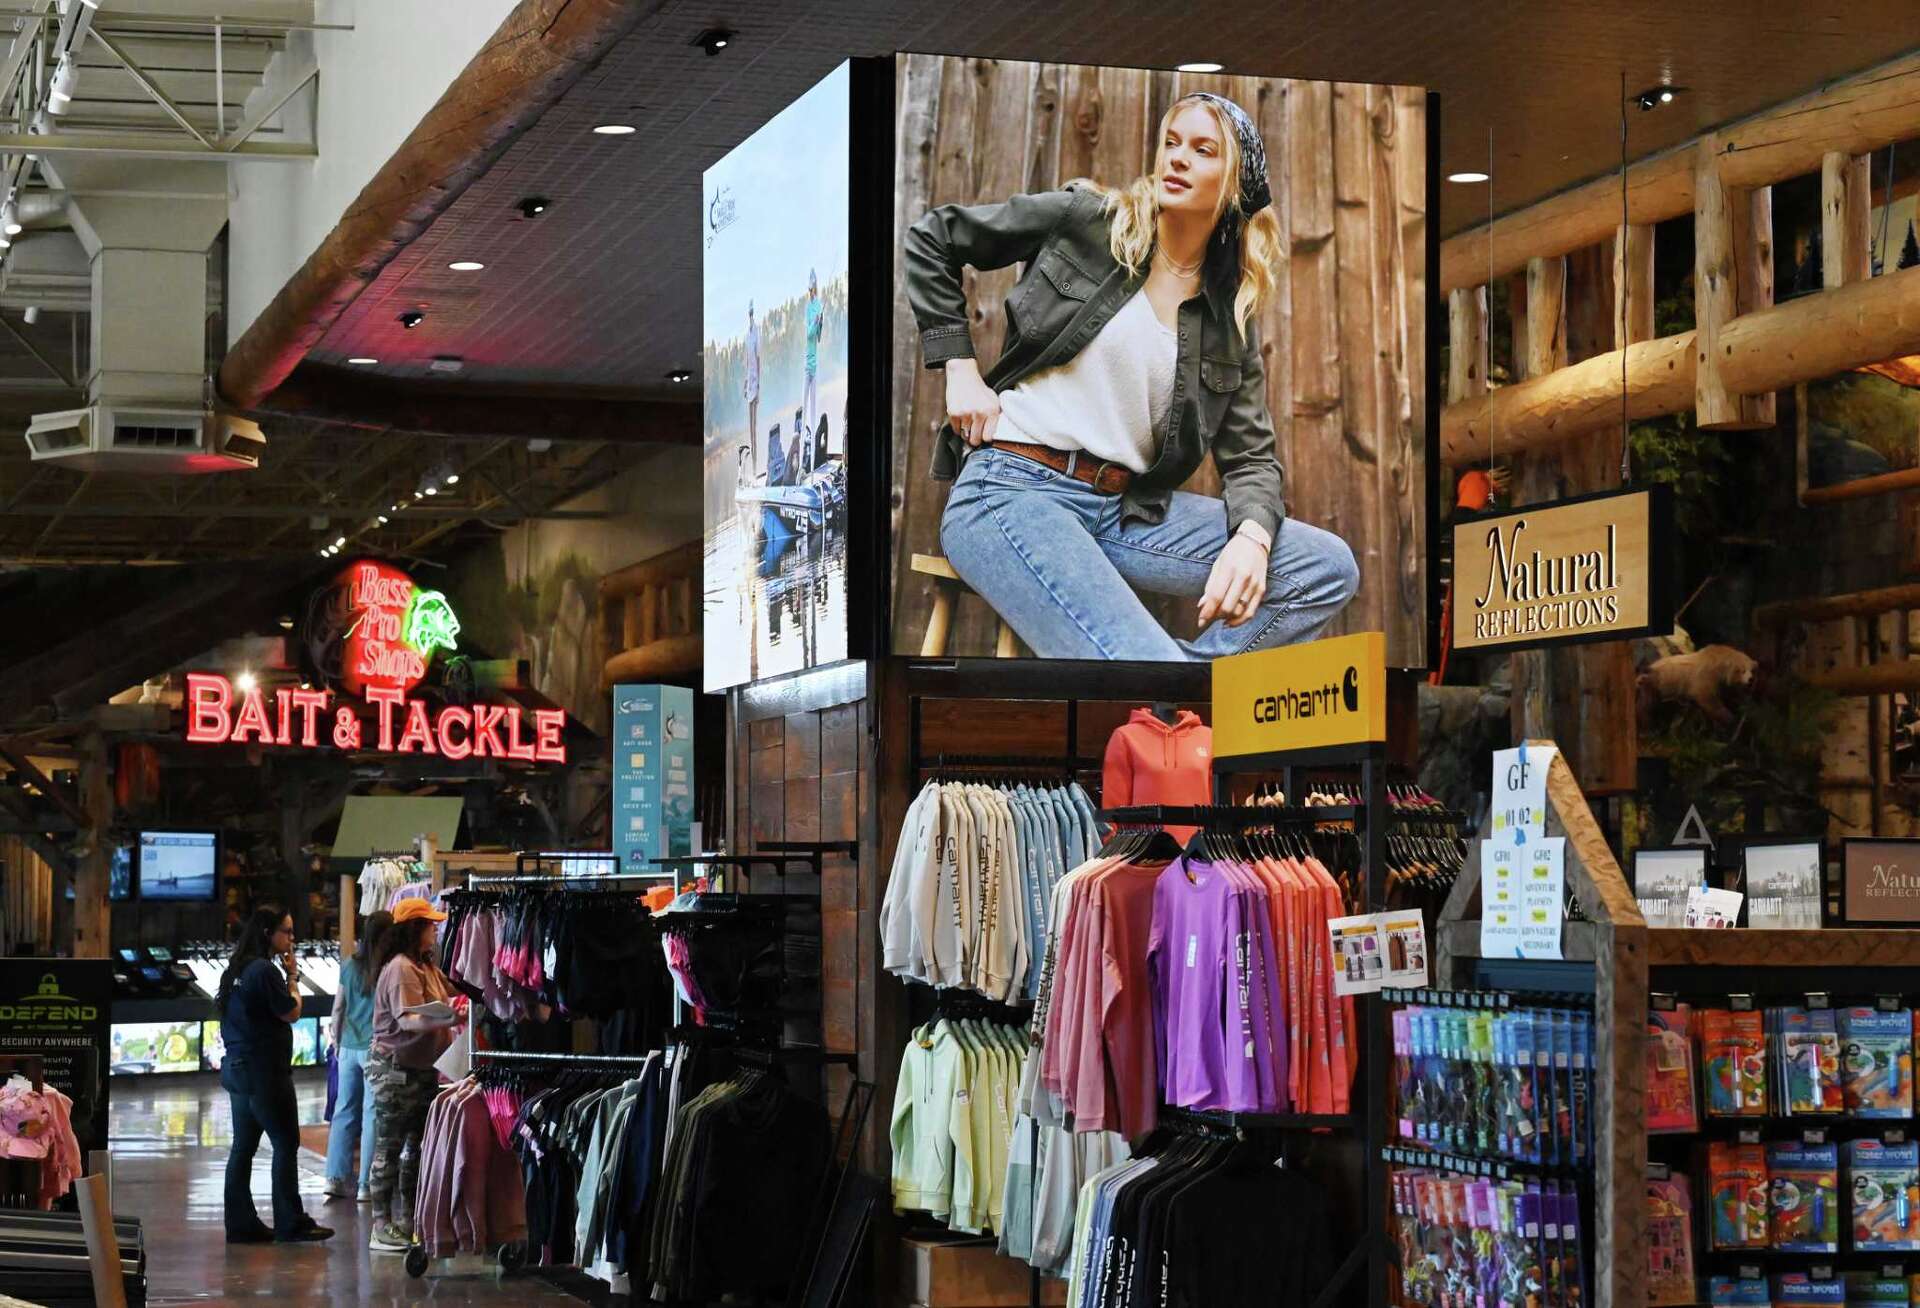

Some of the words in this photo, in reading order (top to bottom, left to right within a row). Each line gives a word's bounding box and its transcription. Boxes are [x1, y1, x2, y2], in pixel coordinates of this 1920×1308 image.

[1475, 520, 1617, 608] Natural
[358, 565, 413, 608] Bass
[360, 606, 400, 641] Pro
[1474, 595, 1618, 639] REFLECTIONS
[359, 641, 426, 683] Shops
[187, 672, 328, 747] BAIT
[333, 705, 362, 749] &
[365, 685, 566, 763] TACKLE
[1253, 682, 1340, 724] carhartt
[1507, 762, 1531, 791] GF
[1505, 809, 1515, 826] 01
[1519, 807, 1530, 825] 02
[0, 1006, 98, 1020] DEFEND
[2, 1037, 43, 1046] SECURITY
[44, 1037, 92, 1046] ANYWHERE
[43, 1057, 73, 1065] ecurity
